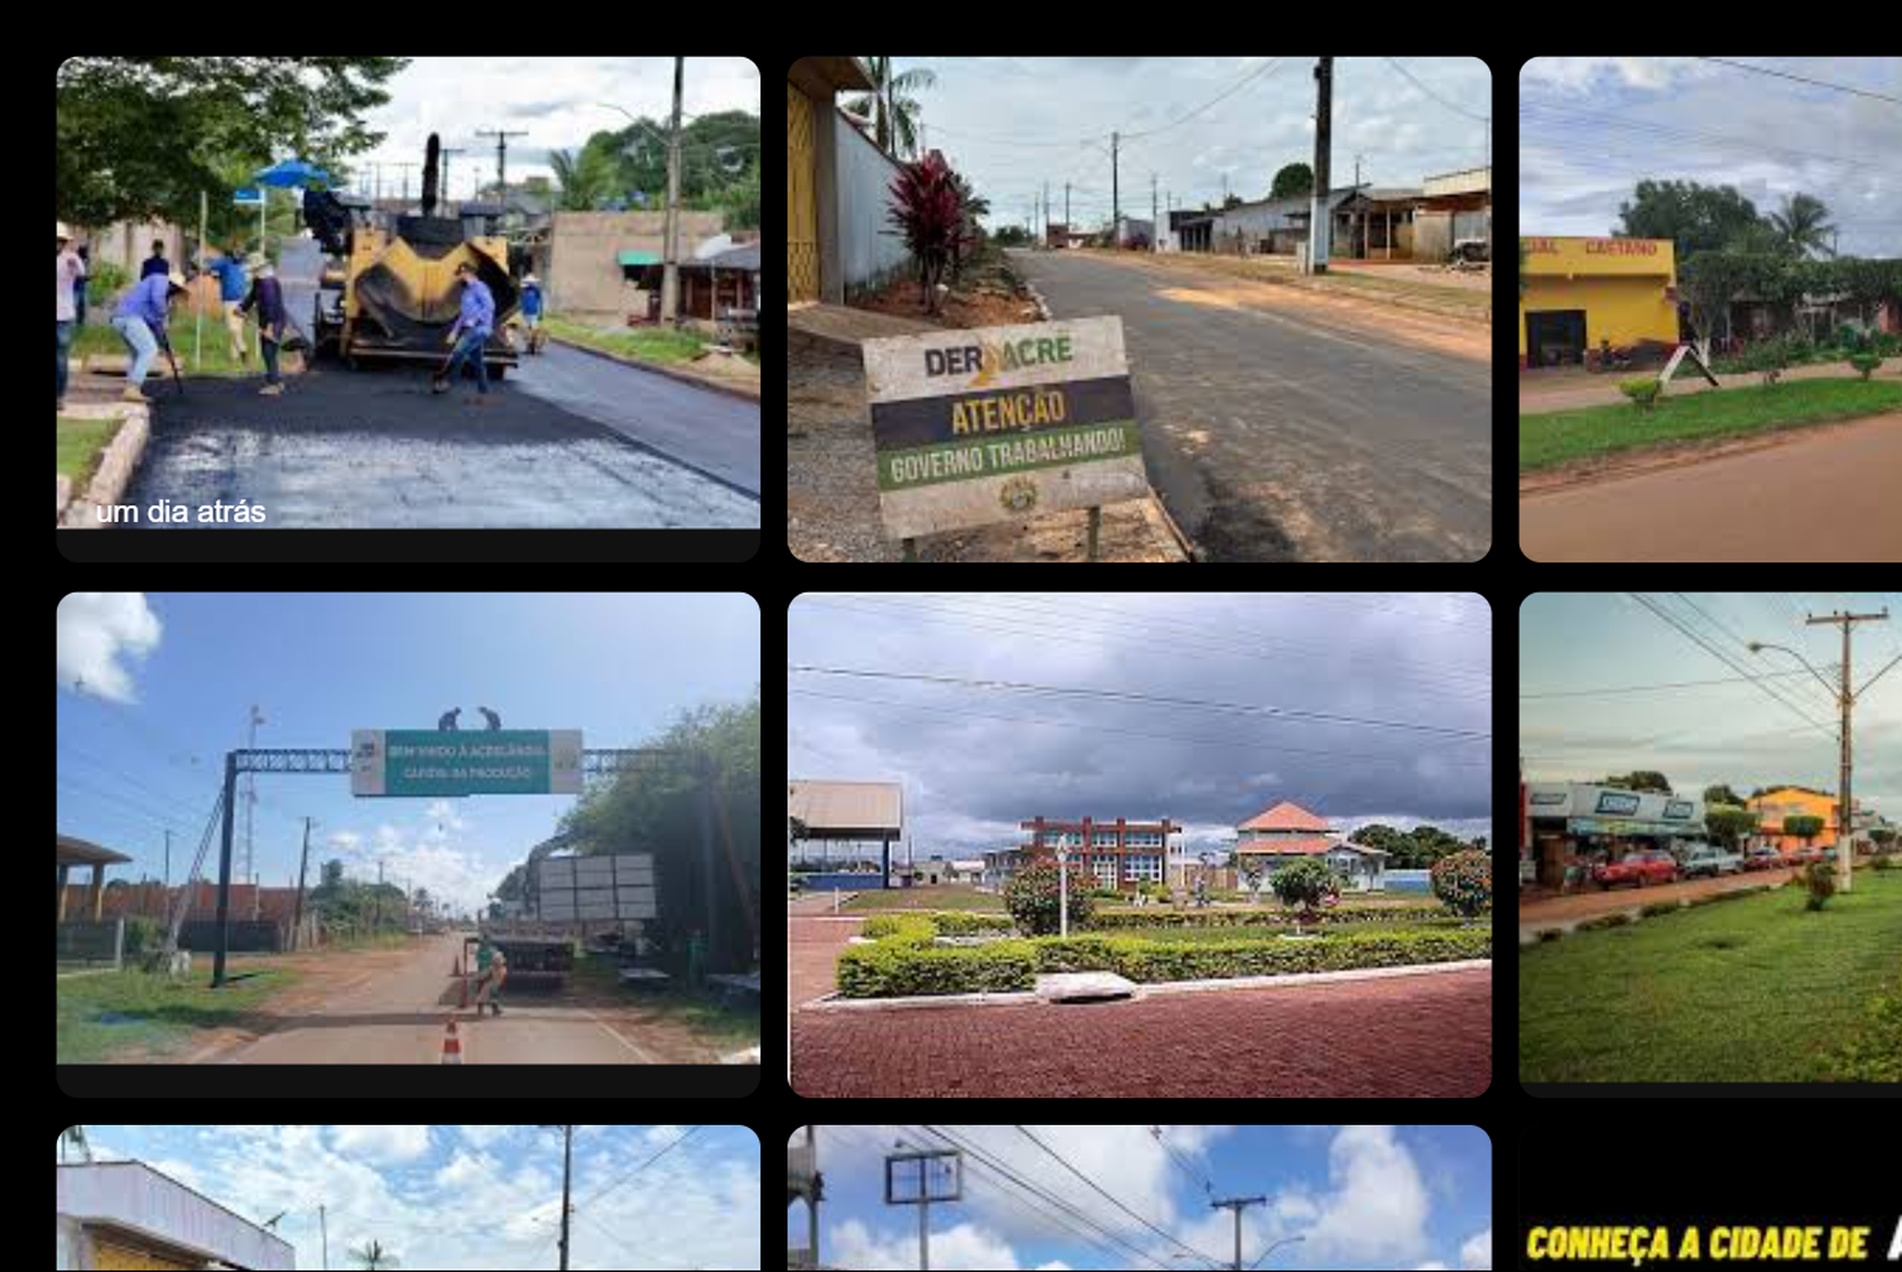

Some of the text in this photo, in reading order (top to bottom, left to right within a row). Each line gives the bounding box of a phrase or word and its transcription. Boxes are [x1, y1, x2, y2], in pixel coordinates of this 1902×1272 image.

[925, 335, 1074, 377] DER ACRE
[953, 388, 1066, 432] ATENÇÃO
[890, 427, 1125, 482] GOVERNO TRABALHANDO!
[1527, 1226, 1670, 1266] CONHEÇA
[1678, 1227, 1700, 1259] A
[1710, 1226, 1823, 1259] CIDADE
[1828, 1227, 1871, 1259] DE
